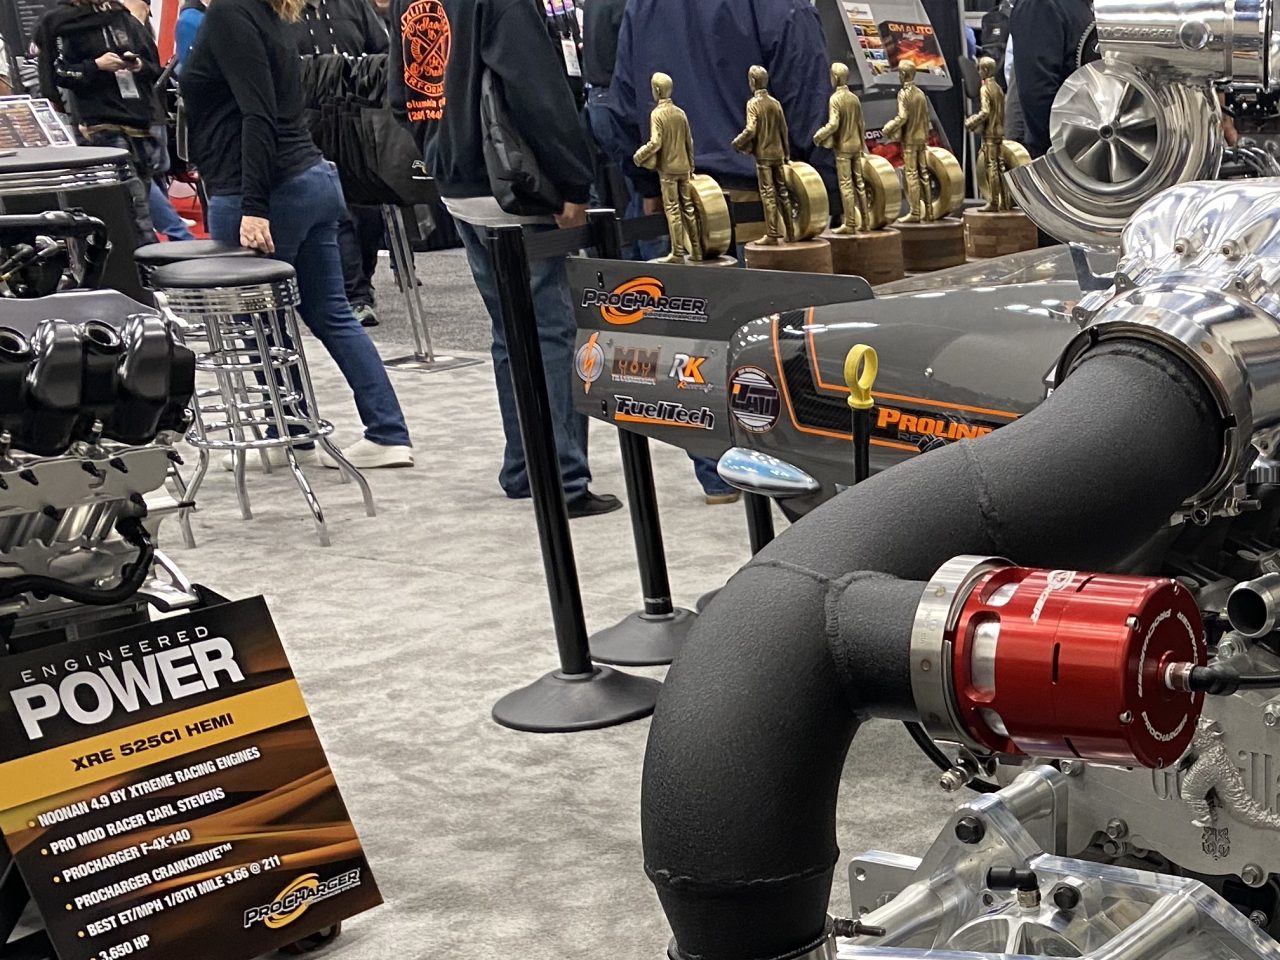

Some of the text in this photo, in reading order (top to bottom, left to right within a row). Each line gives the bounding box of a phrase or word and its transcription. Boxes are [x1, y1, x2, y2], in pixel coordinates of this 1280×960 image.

[614, 395, 714, 430] FuelTech
[20, 625, 209, 683] ENGINEERED
[8, 633, 246, 743] POWER
[70, 712, 234, 771] XRE 525CI HEMI
[37, 746, 261, 827] NOONAN 4.9 BY XTREME RACING ENGINES
[49, 786, 226, 855] PRO MOD RACER CARL STEVENS
[61, 827, 191, 883] PROCHARGER F-4X-140
[74, 871, 152, 910] PROCHARGER
[86, 854, 281, 937] BEST ET/MPH 1/8TH MILE 3.66 @ 211
[239, 866, 363, 928] PROCHARGER
[132, 933, 151, 951] HP
